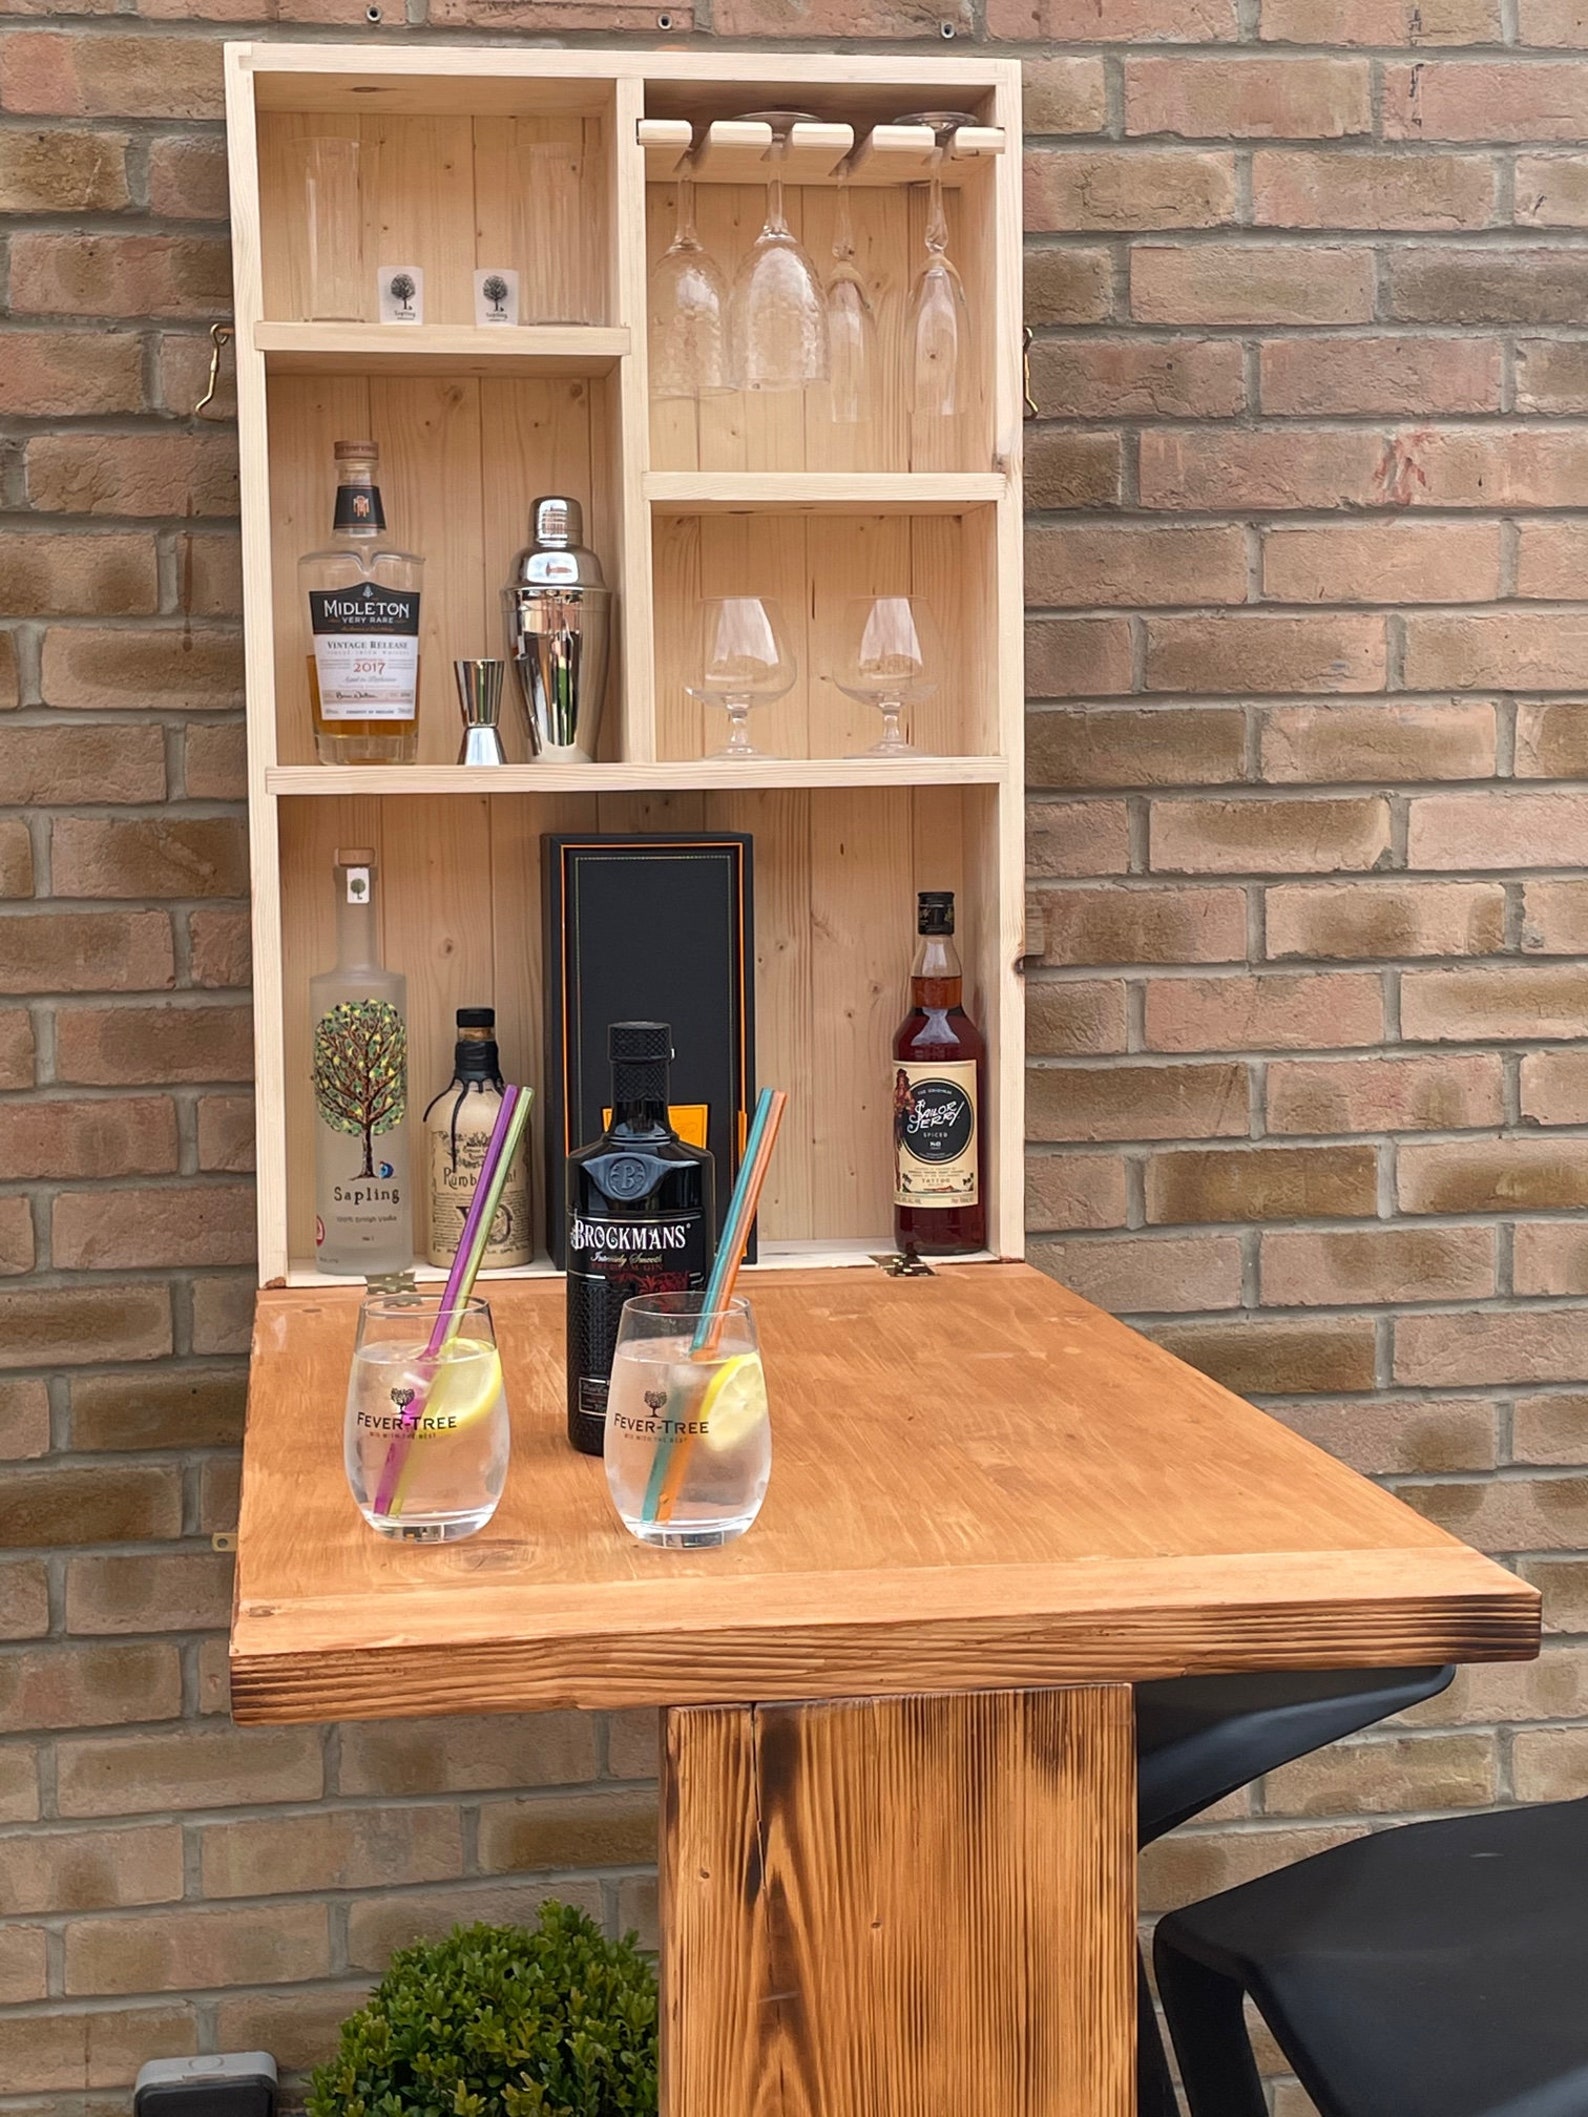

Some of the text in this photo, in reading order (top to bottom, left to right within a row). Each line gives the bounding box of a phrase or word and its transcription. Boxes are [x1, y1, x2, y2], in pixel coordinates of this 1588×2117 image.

[323, 599, 410, 619] MIDLETON
[341, 616, 366, 624] VERY
[369, 616, 394, 624] RARE
[327, 641, 408, 649] VINTAGE RELEASE
[353, 662, 386, 675] 2017
[333, 1185, 400, 1206] Sapling
[570, 1219, 687, 1251] BROCKMANS
[357, 1411, 457, 1431] FEVER-TREE
[613, 1412, 710, 1435] FEVER-TREE
